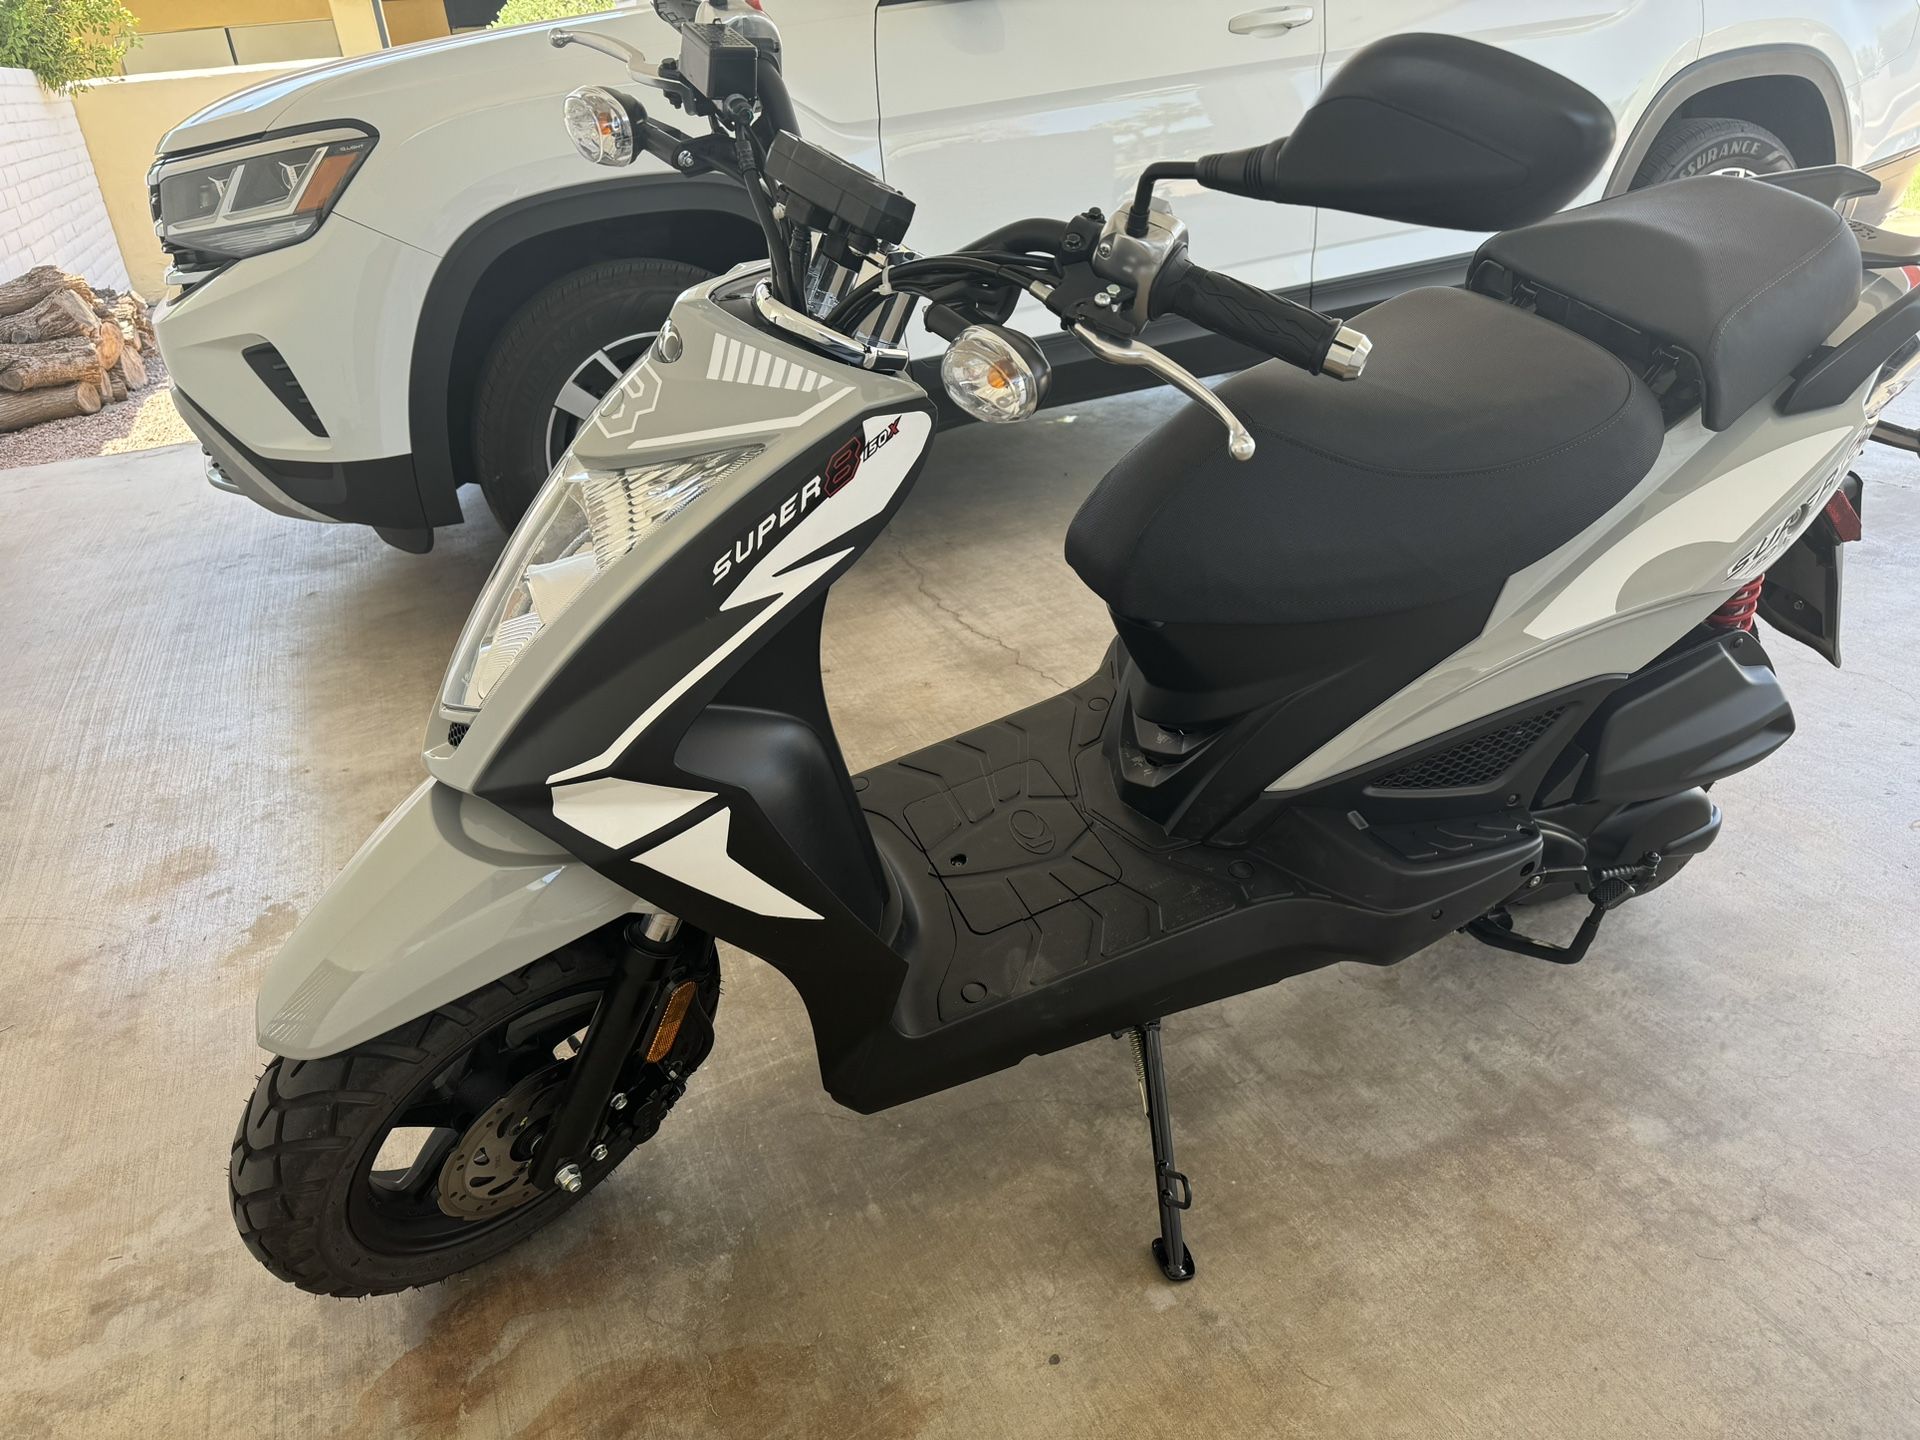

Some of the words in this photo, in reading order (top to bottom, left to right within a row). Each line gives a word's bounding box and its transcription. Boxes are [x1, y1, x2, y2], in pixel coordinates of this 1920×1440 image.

[1678, 140, 1761, 178] SSURANCE
[712, 475, 822, 586] SUPER
[862, 415, 902, 462] 150X
